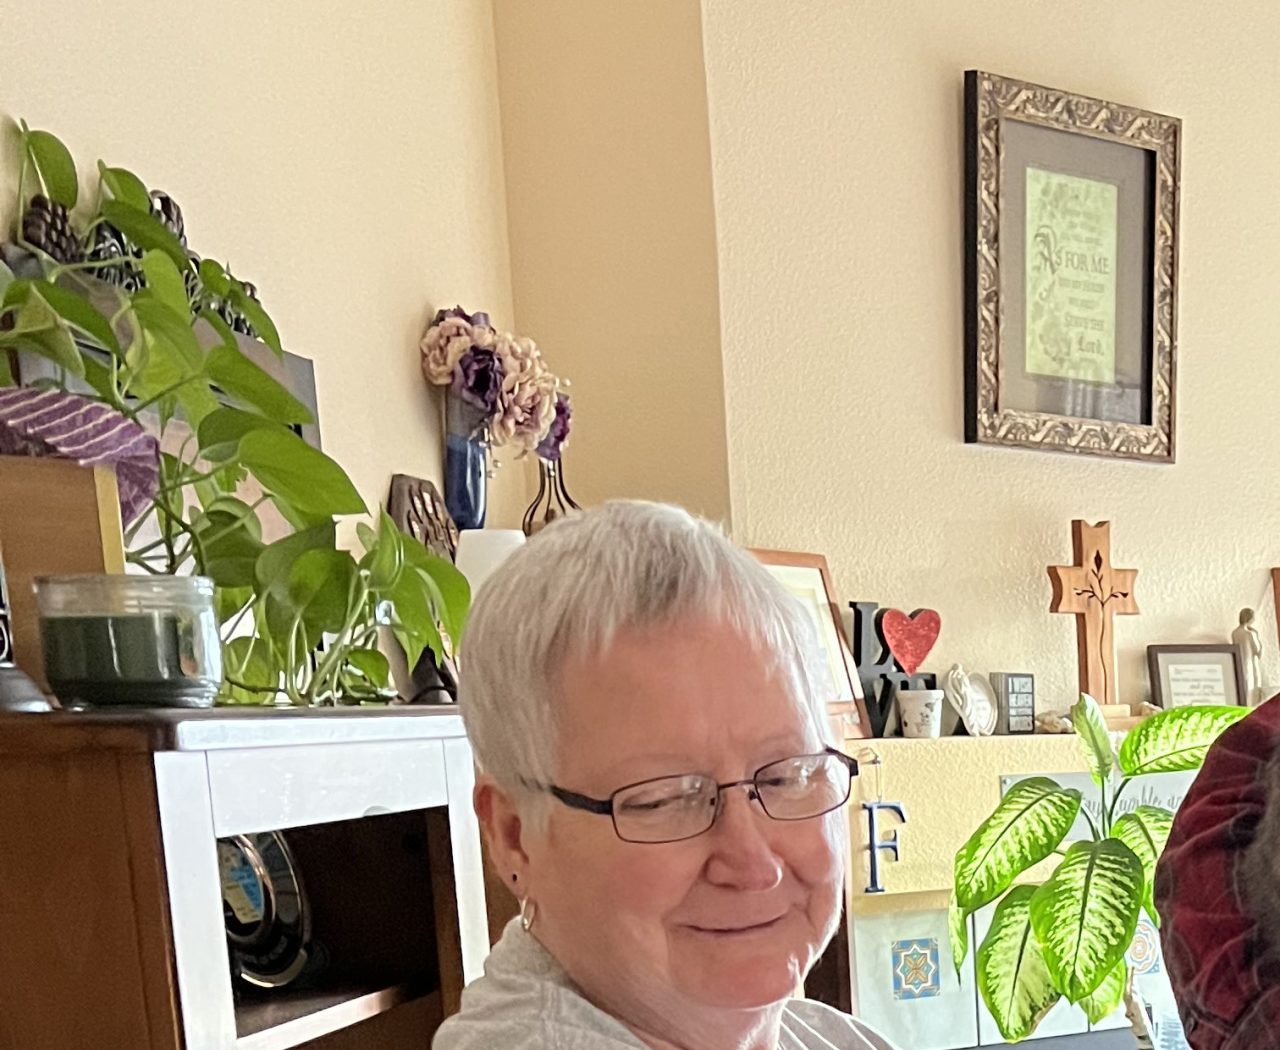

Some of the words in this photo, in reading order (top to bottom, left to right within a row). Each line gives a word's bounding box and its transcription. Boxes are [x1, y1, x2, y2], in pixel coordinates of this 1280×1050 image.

[1065, 251, 1089, 273] FOR
[1090, 254, 1110, 275] ME
[862, 802, 906, 893] F
